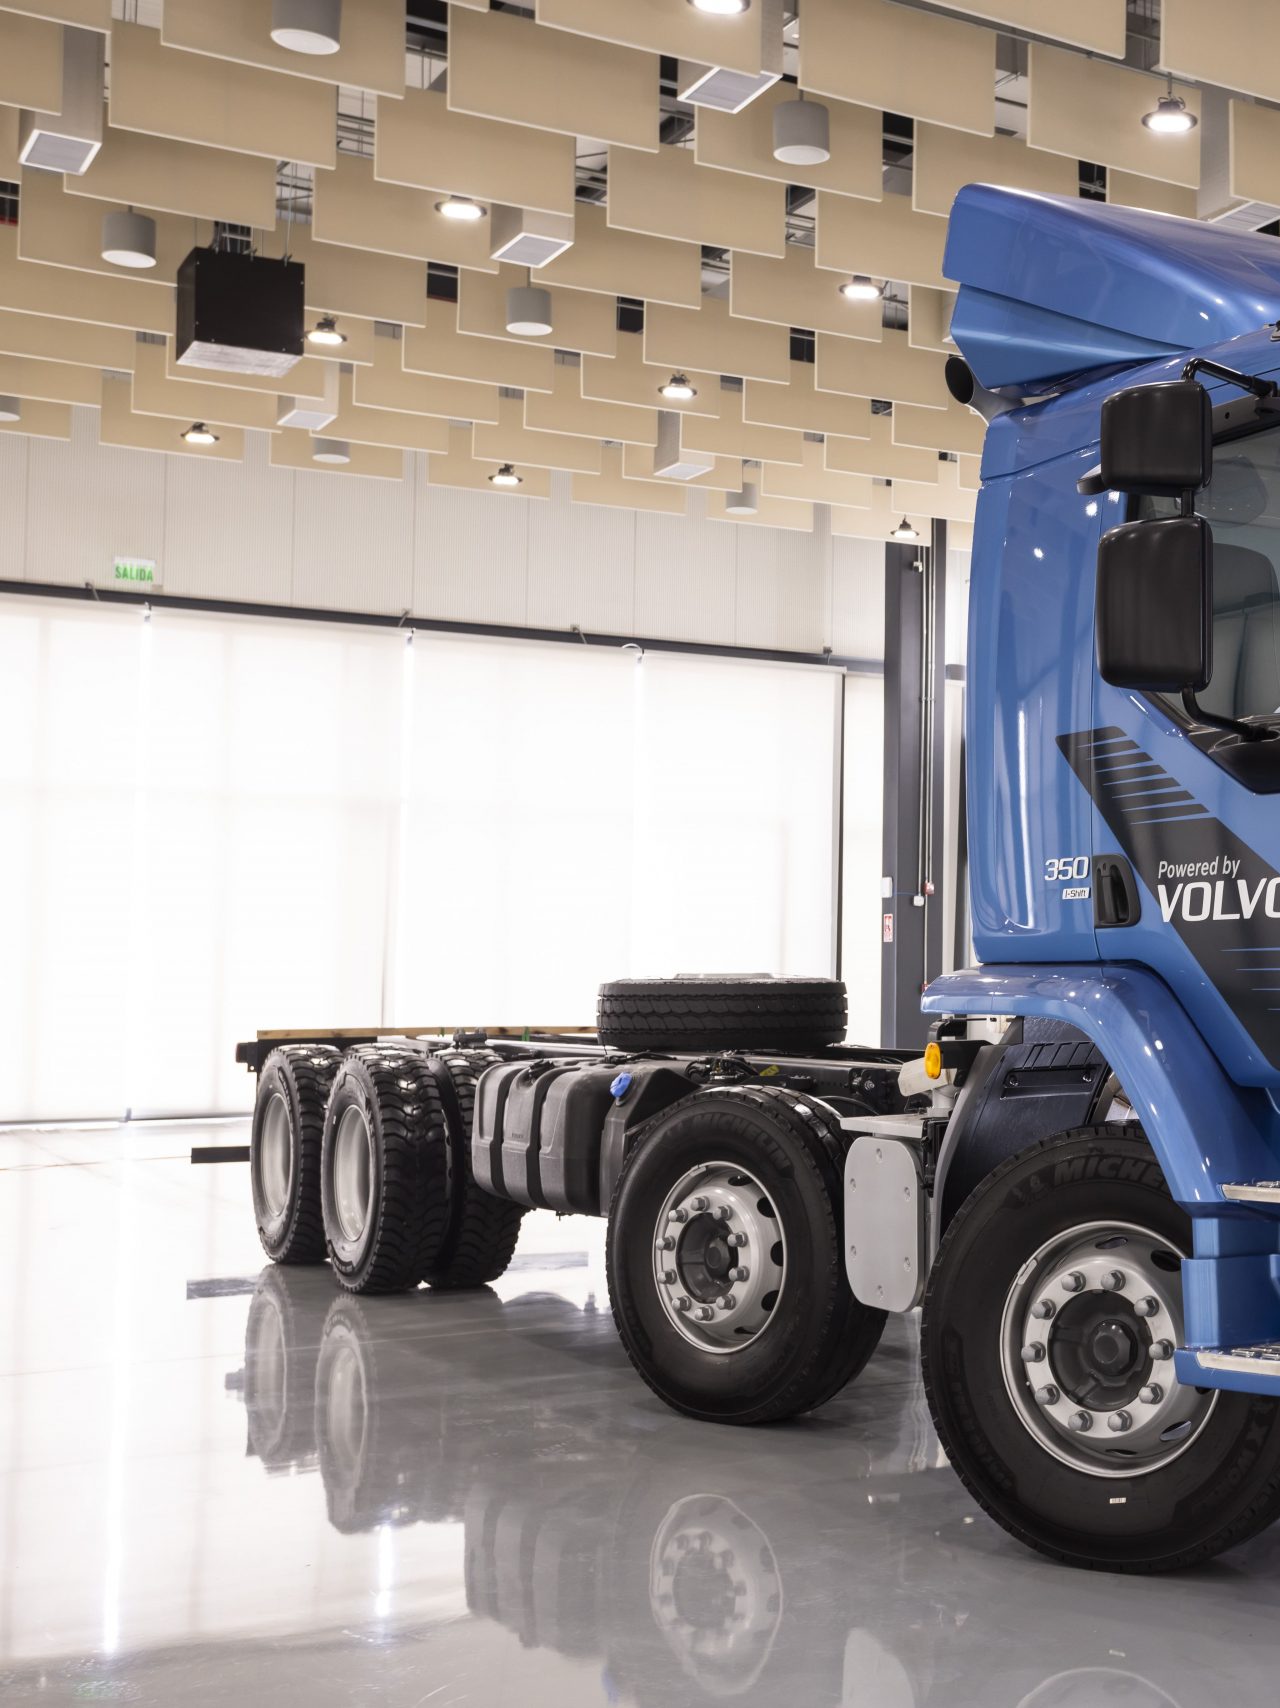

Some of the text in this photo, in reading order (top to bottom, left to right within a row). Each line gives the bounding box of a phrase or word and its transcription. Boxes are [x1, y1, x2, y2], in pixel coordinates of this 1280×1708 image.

[115, 564, 153, 582] SALIDA
[1044, 856, 1089, 881] 350
[1157, 855, 1241, 879] Powered by
[1065, 889, 1086, 898] I-Shift
[691, 1112, 791, 1170] MICHELIN
